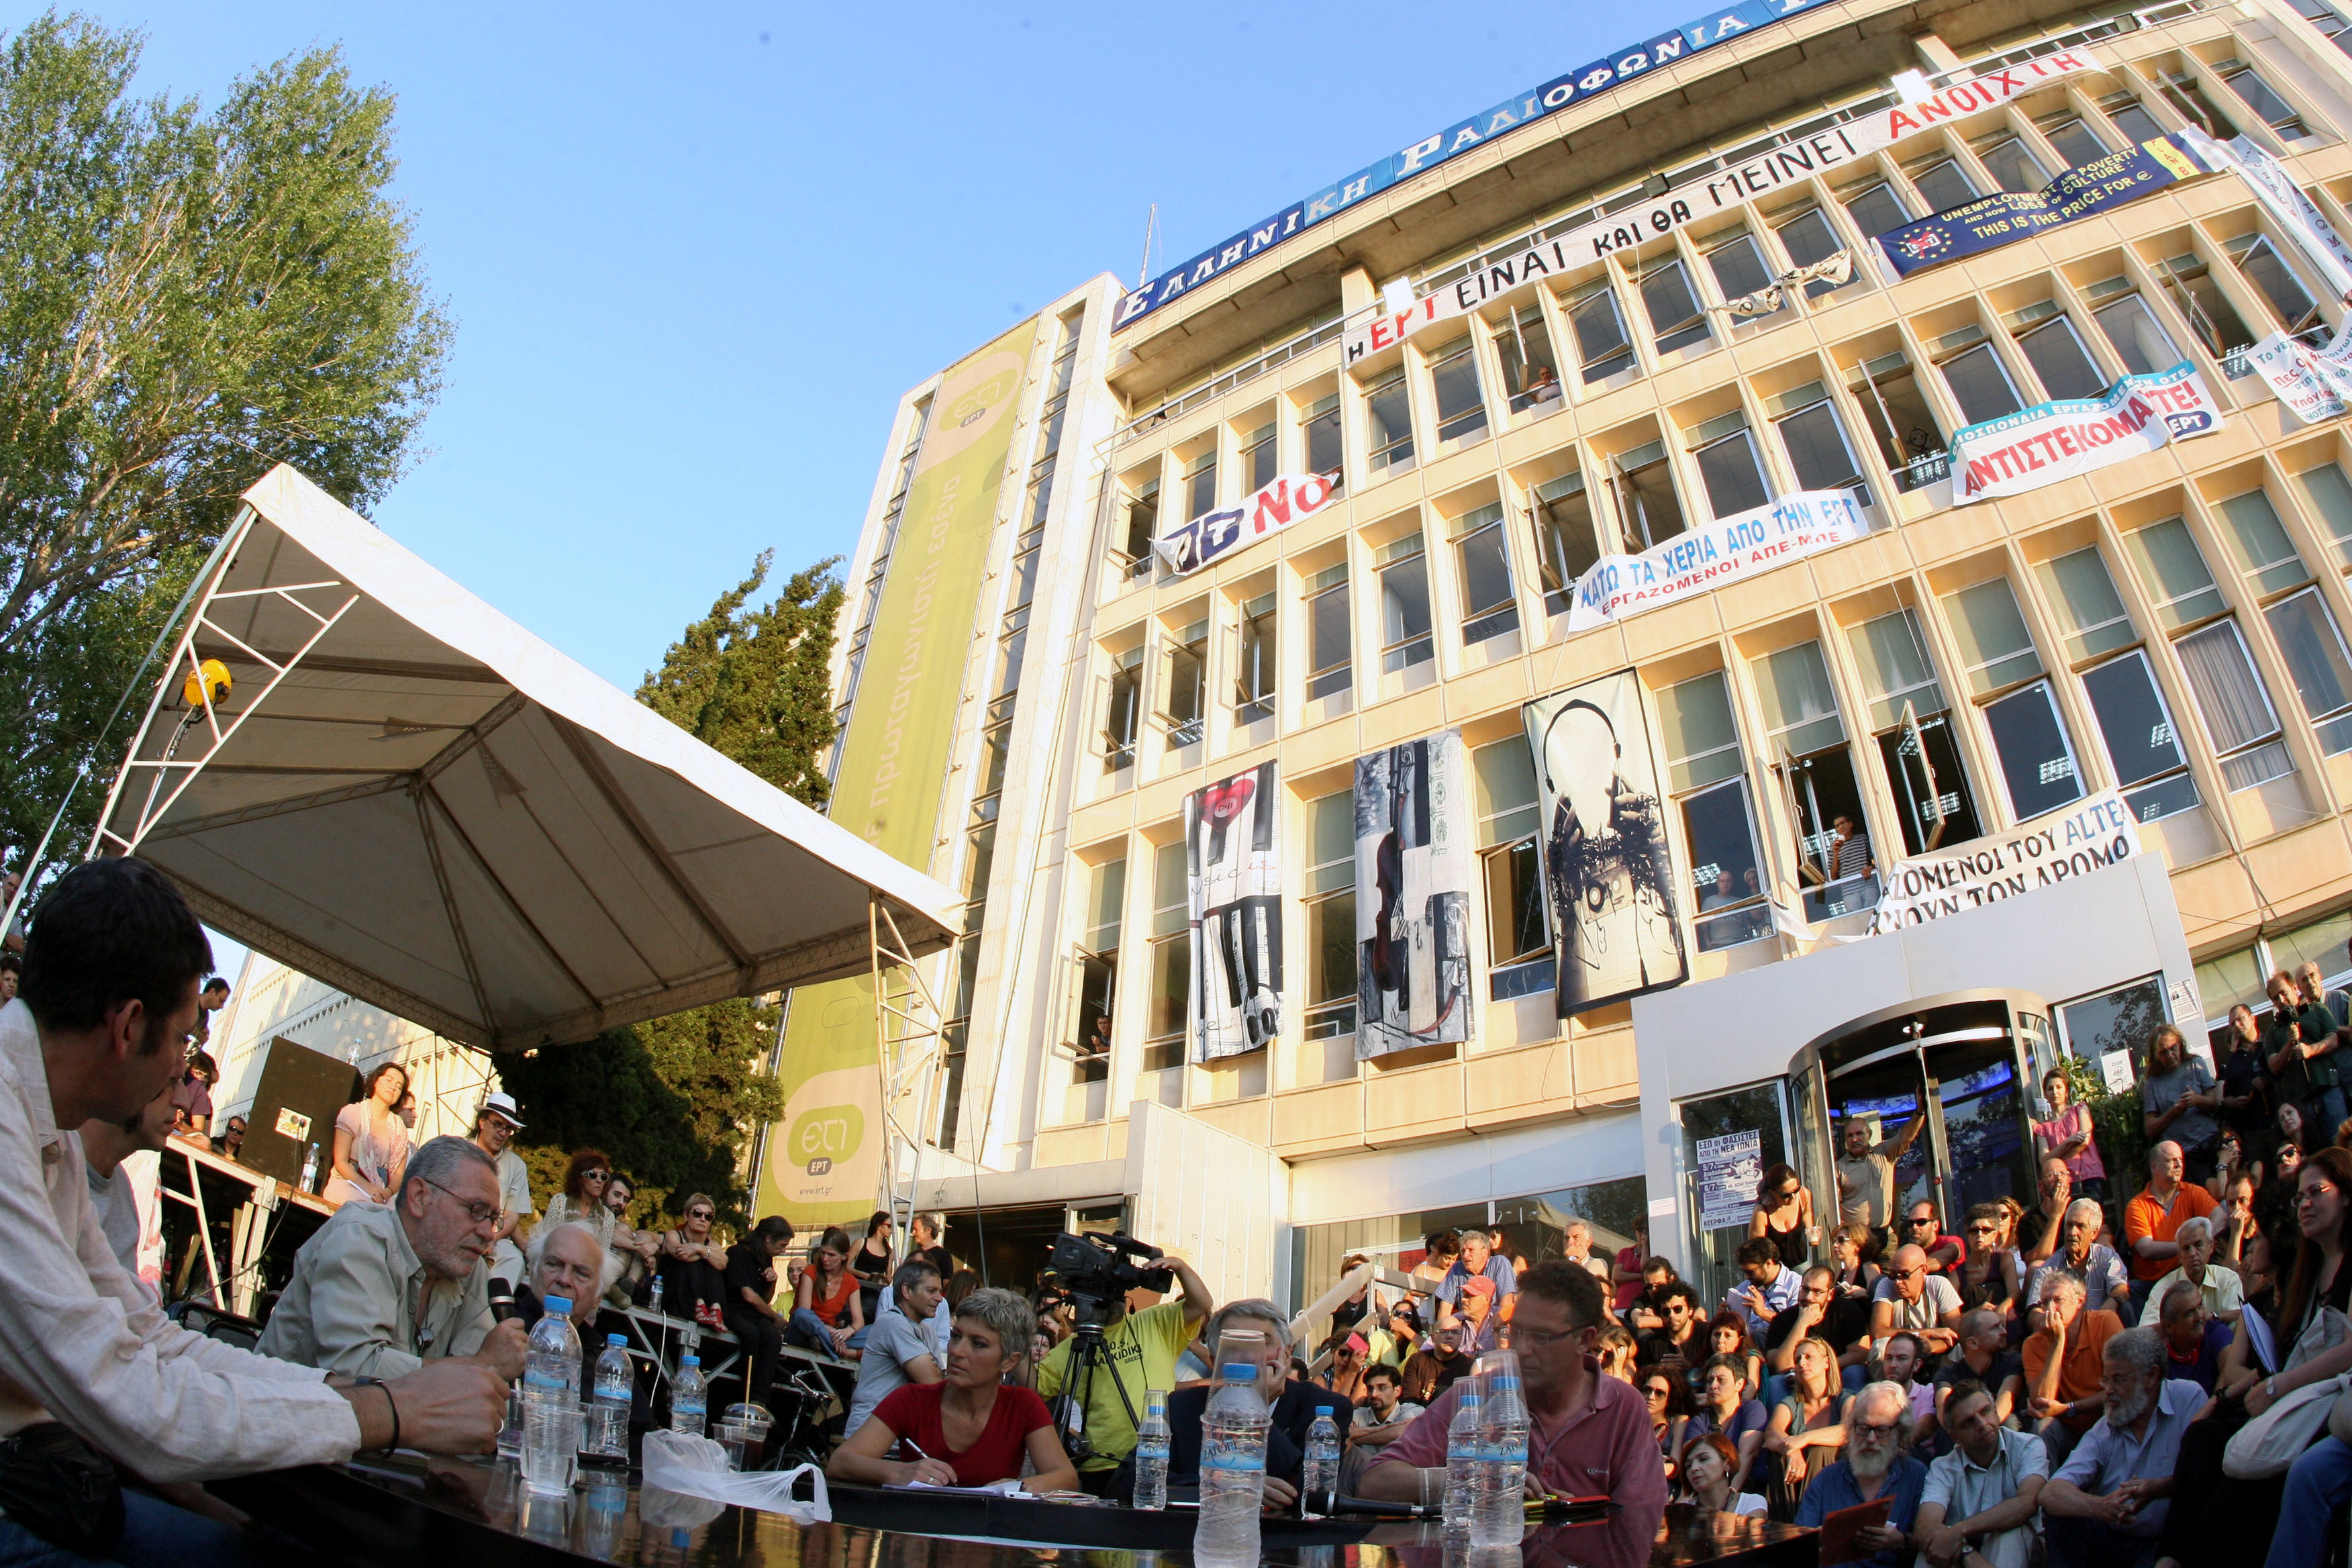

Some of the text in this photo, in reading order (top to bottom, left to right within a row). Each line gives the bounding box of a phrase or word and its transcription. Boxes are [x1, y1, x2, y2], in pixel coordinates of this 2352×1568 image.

[1116, 15, 1749, 327] ΕΛΛΗΝΙΚΗ ΡΑΔΙΟΦΩΝΙΑ
[1457, 242, 1565, 309] ΕΙΝΑΙ
[1593, 223, 1641, 258] ΚΑΙ
[1651, 201, 1692, 233] ΘΑ
[1708, 129, 1857, 206] ΜΕΙΝΕΙ
[1890, 52, 2085, 139] ΑΝΟΙΧΤΗ
[1941, 185, 2058, 222] UNEMPLOYMENT
[2077, 147, 2140, 175] POVERTY
[1972, 221, 2010, 239] THIS
[2014, 215, 2029, 230] IS
[2032, 211, 2062, 227] THE
[2061, 188, 2105, 219] PRICE
[2105, 177, 2137, 195] FOR
[2009, 199, 2047, 211] LOSS
[2051, 195, 2063, 205] OF
[2159, 368, 2189, 385] ΟΤΕ
[2168, 415, 2202, 434] ΕΡΤ
[1253, 477, 1334, 534] NO
[1581, 565, 1619, 609] ΚΑΤΩ
[1630, 562, 1655, 585] ΤΑ
[1662, 535, 1718, 578] ΧΕΡΙΑ
[1727, 519, 1765, 554] ΑΠΟ
[1771, 502, 1815, 535] ΤΗΝ
[1602, 558, 1740, 616] ΕΡΓΑΖΟΜΕΝΟΙ
[2007, 827, 2058, 863] ΤΟΥ
[1966, 873, 2027, 906] ΤΟΝ
[1720, 1144, 1735, 1154] ΝΕΑ
[1737, 1139, 1758, 1150] ΙΩΝΙΑ
[1722, 1131, 1758, 1144] ΦΑΣΙΣΤΕΣ
[810, 1161, 828, 1173] ΕΡΤ
[799, 1185, 833, 1197] www.ert.gr
